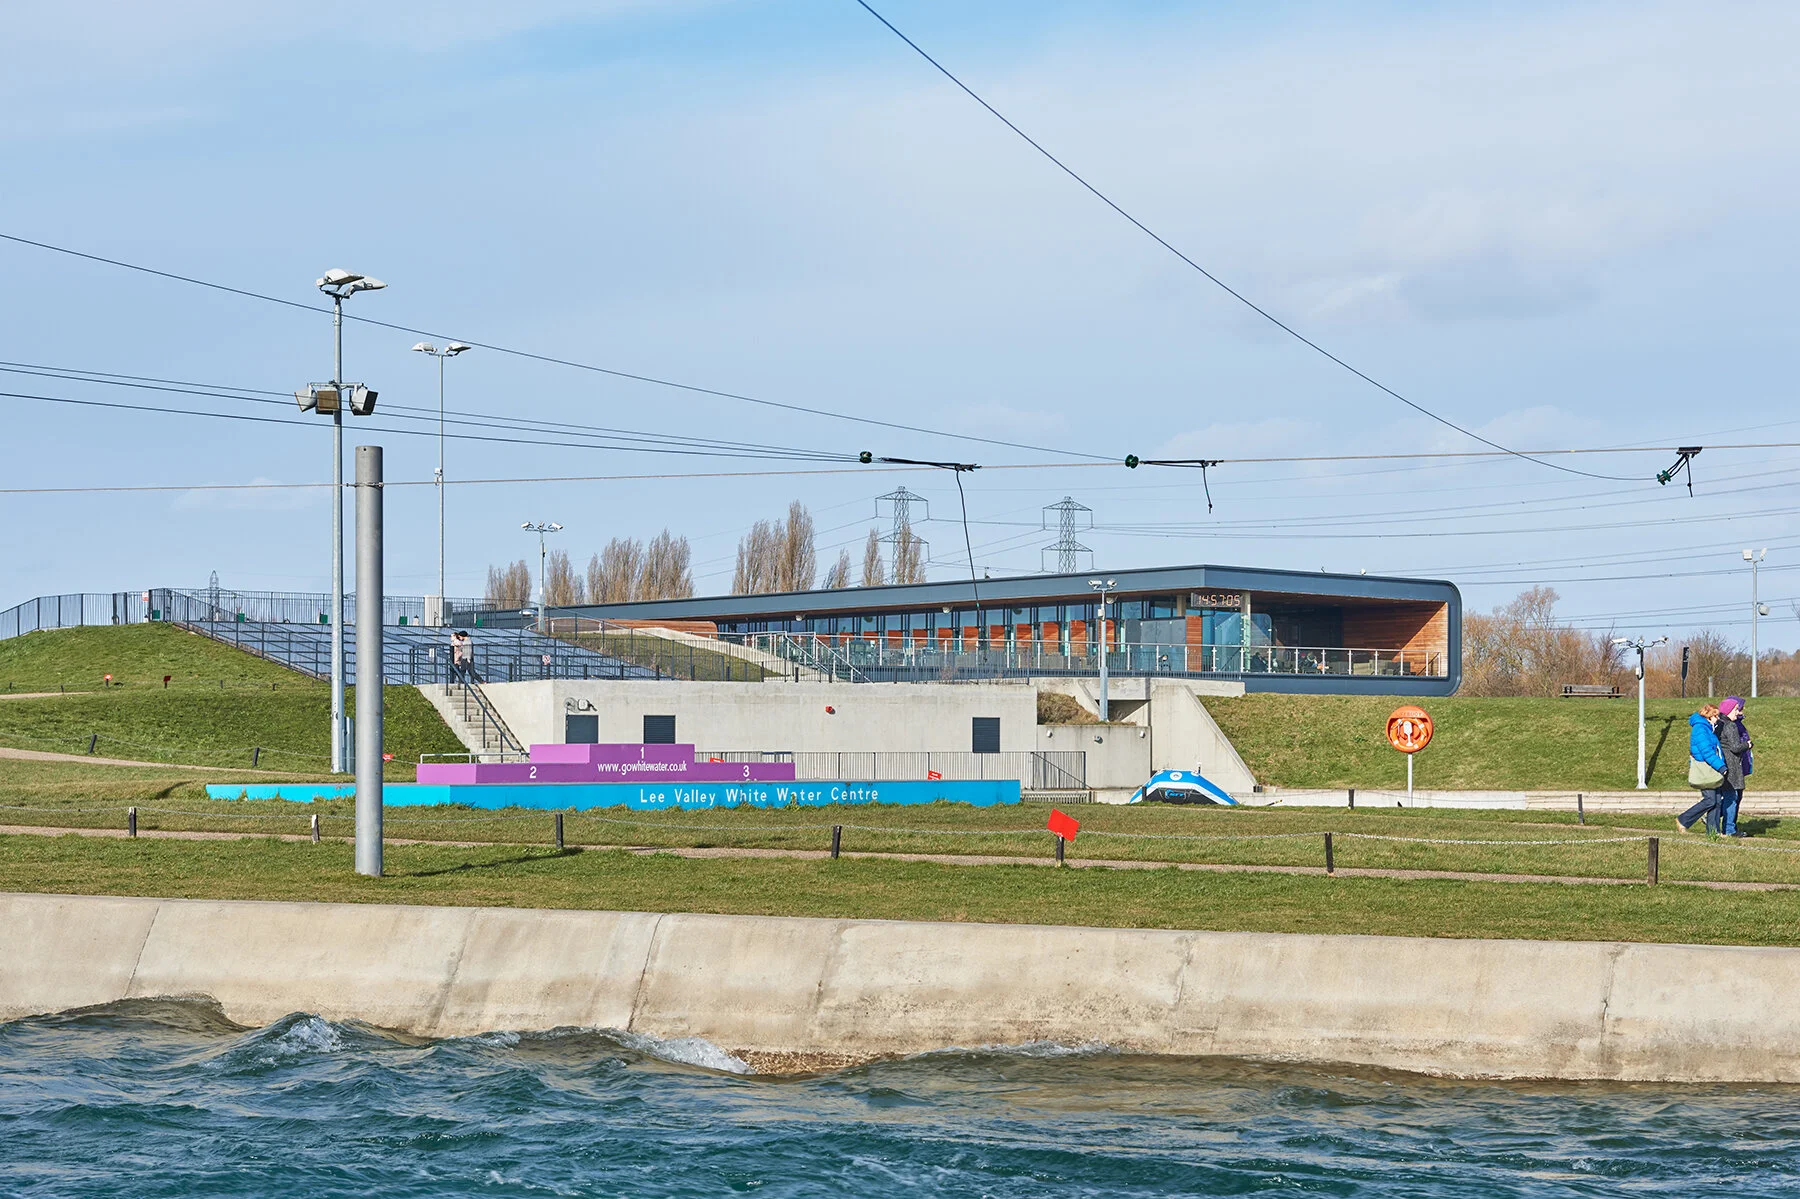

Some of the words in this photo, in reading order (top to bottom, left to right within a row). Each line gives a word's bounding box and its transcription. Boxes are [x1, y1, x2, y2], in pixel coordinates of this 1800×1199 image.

[640, 746, 645, 759] 1
[529, 766, 537, 778] 2
[597, 760, 687, 775] www.gowhitewater.co.uk
[743, 765, 750, 777] 3
[640, 789, 665, 803] Lee
[674, 789, 716, 805] Valley
[725, 788, 767, 802] White
[831, 787, 879, 801] Centre
